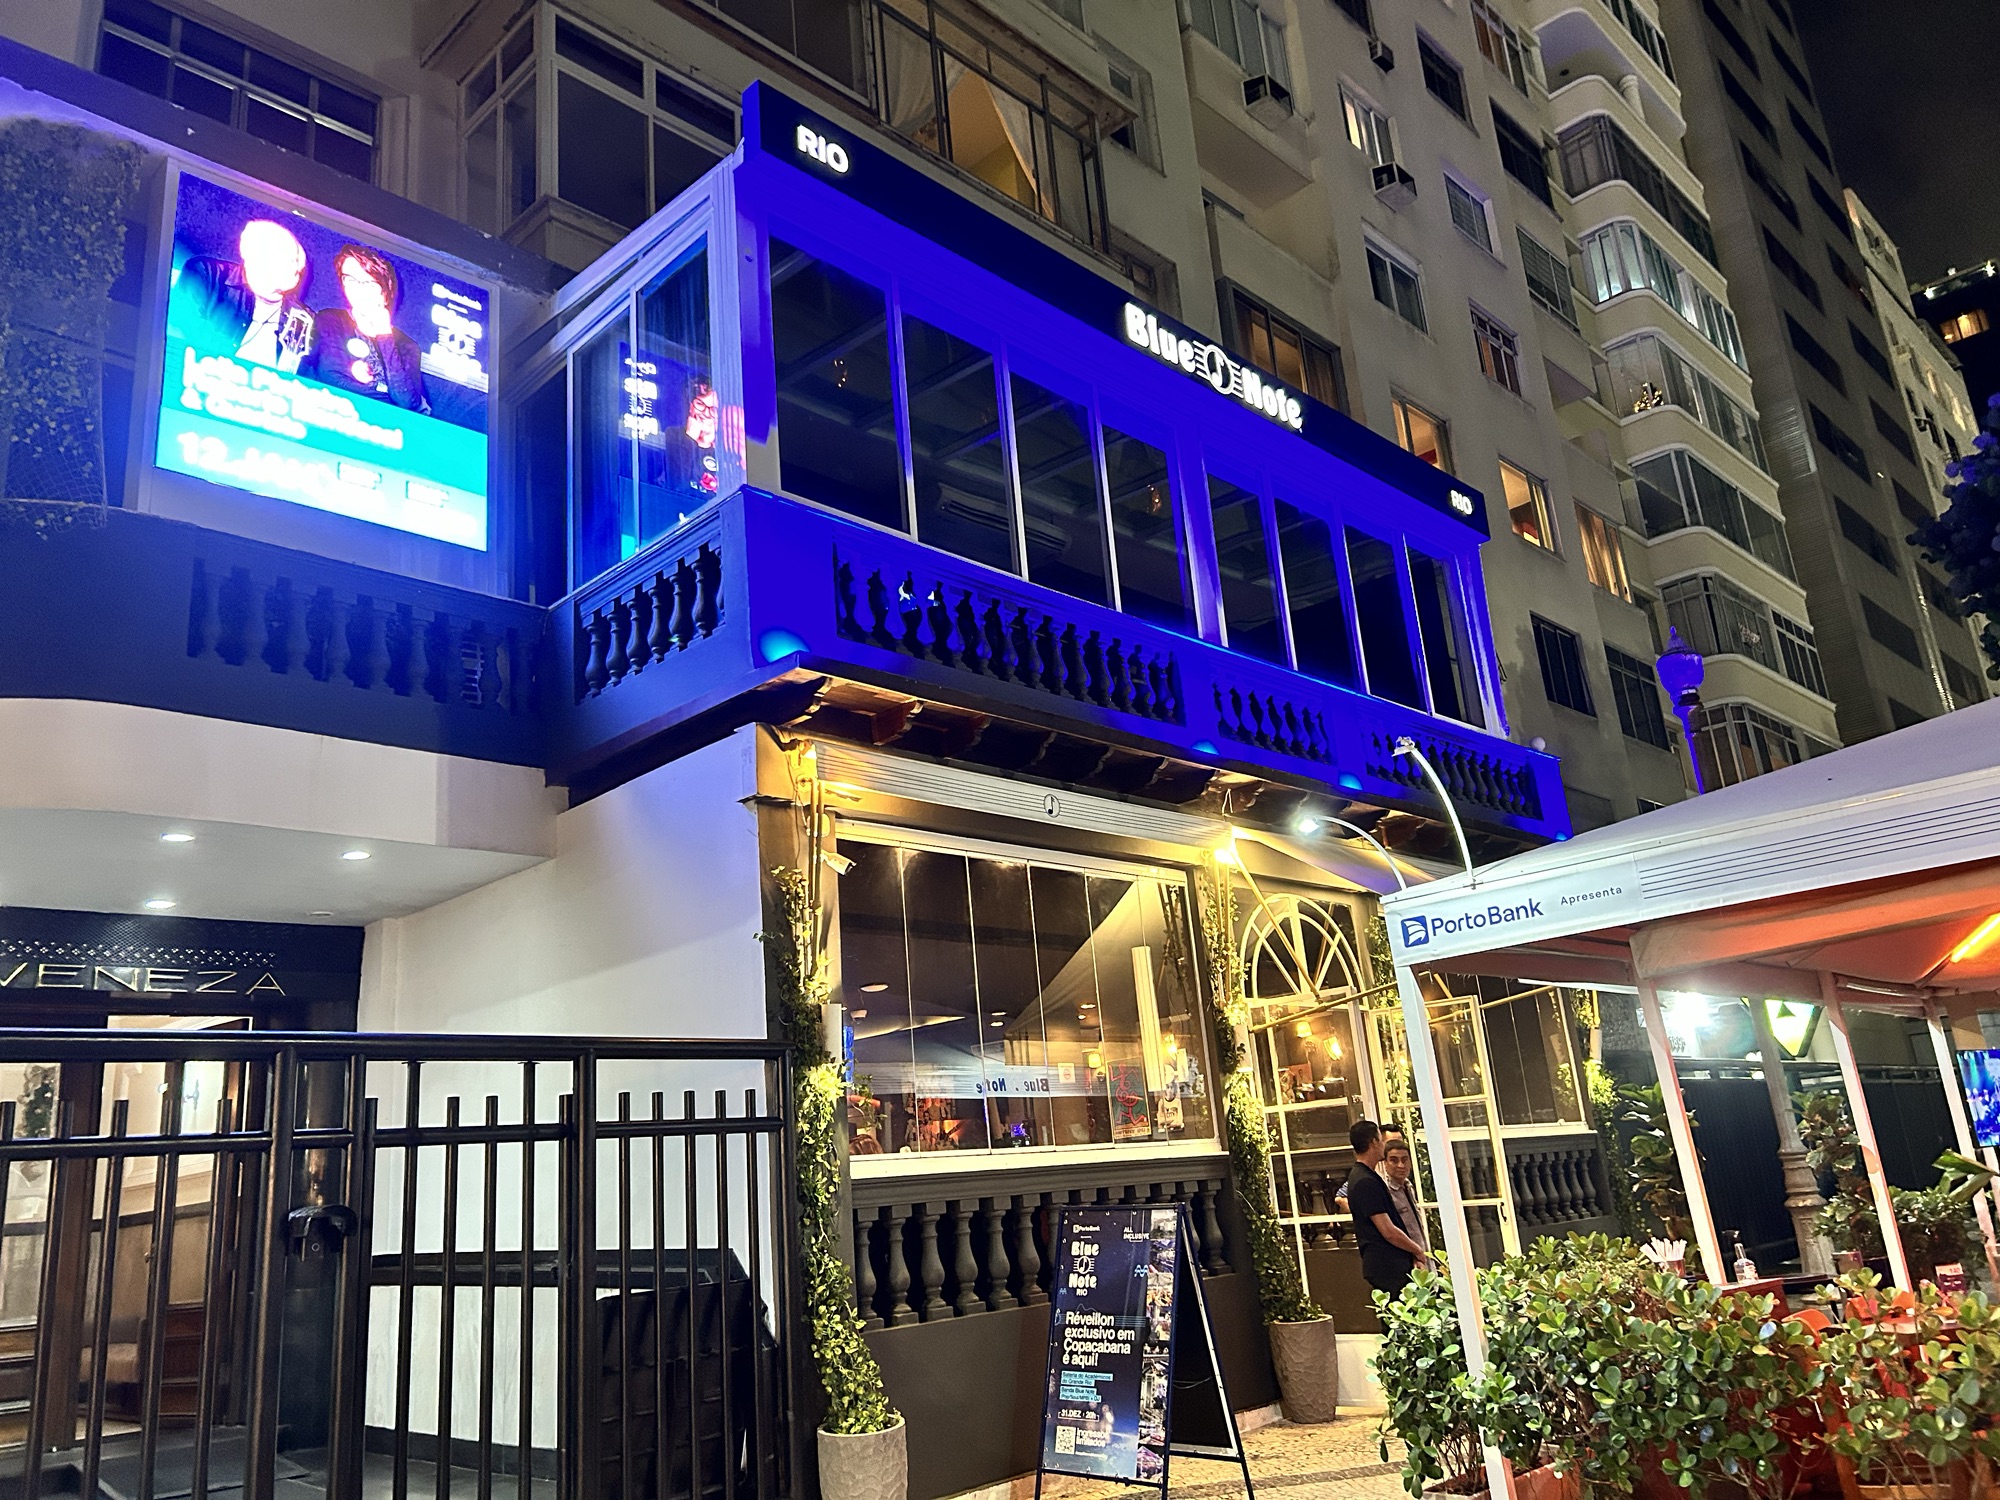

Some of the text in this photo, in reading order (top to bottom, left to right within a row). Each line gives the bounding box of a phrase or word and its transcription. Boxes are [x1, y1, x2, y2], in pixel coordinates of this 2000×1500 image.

[797, 124, 849, 173] RIO
[1125, 302, 1303, 433] Blue Note
[1450, 489, 1473, 515] RIO
[1431, 885, 1623, 936] PortoBank Apresenta
[1123, 1232, 1150, 1240] INCLUSIVE
[1071, 1241, 1100, 1256] Blue
[1068, 1273, 1098, 1289] Note
[1076, 1289, 1088, 1297] RIO
[1065, 1311, 1115, 1327] Réveillon
[1064, 1325, 1135, 1341] exclusivo em
[1063, 1337, 1131, 1355] Copacabana
[1062, 1351, 1099, 1369] é aqui!
[1061, 1408, 1097, 1419] 31.DEZ 20h
